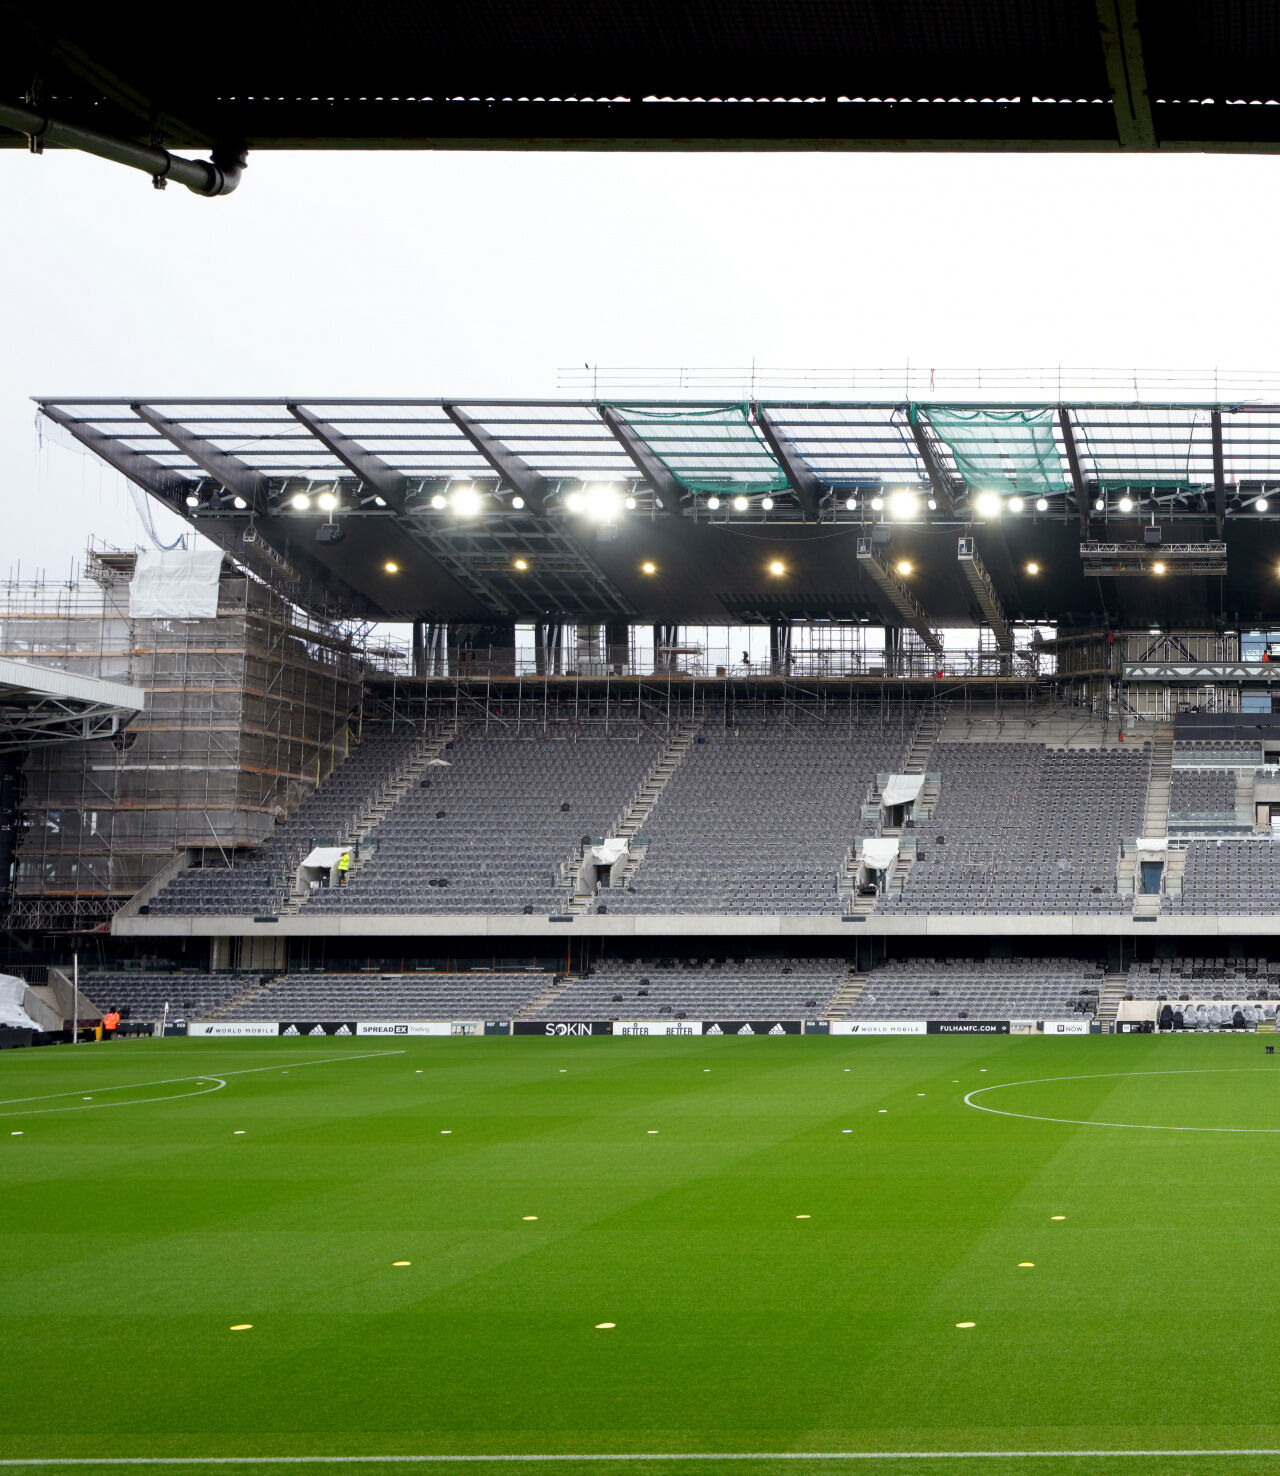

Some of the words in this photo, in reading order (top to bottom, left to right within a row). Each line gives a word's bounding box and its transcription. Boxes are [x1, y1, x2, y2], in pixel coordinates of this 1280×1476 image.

[545, 1023, 592, 1036] SOKIN
[622, 1027, 649, 1035] BETTER
[666, 1027, 693, 1035] BETTER
